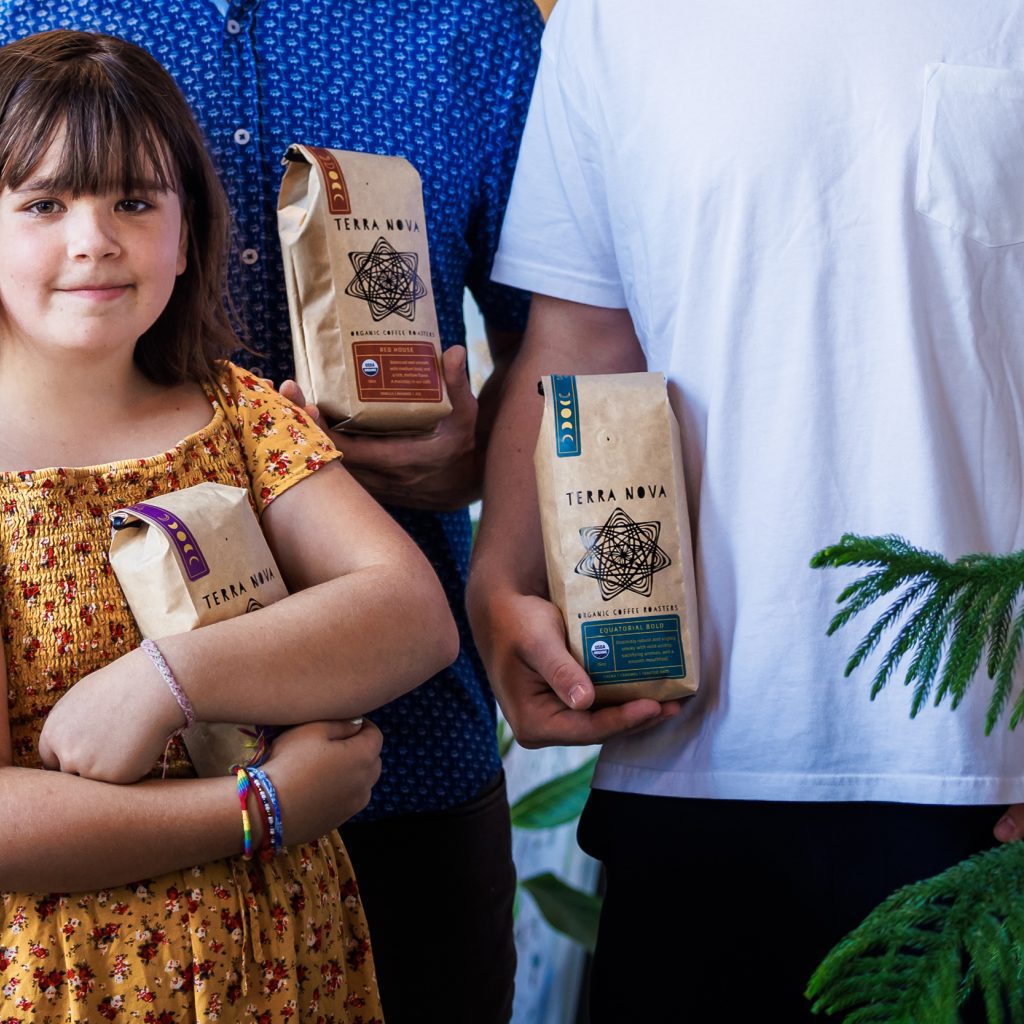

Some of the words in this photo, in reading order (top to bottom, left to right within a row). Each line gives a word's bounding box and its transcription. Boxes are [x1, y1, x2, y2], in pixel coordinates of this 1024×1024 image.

[334, 218, 379, 231] TERRA
[386, 219, 420, 232] NOVA
[566, 489, 616, 506] TERRA
[625, 484, 667, 500] NOVA
[202, 580, 247, 609] TERRA
[250, 567, 275, 589] NOVA
[599, 624, 643, 634] EQUATORIAL
